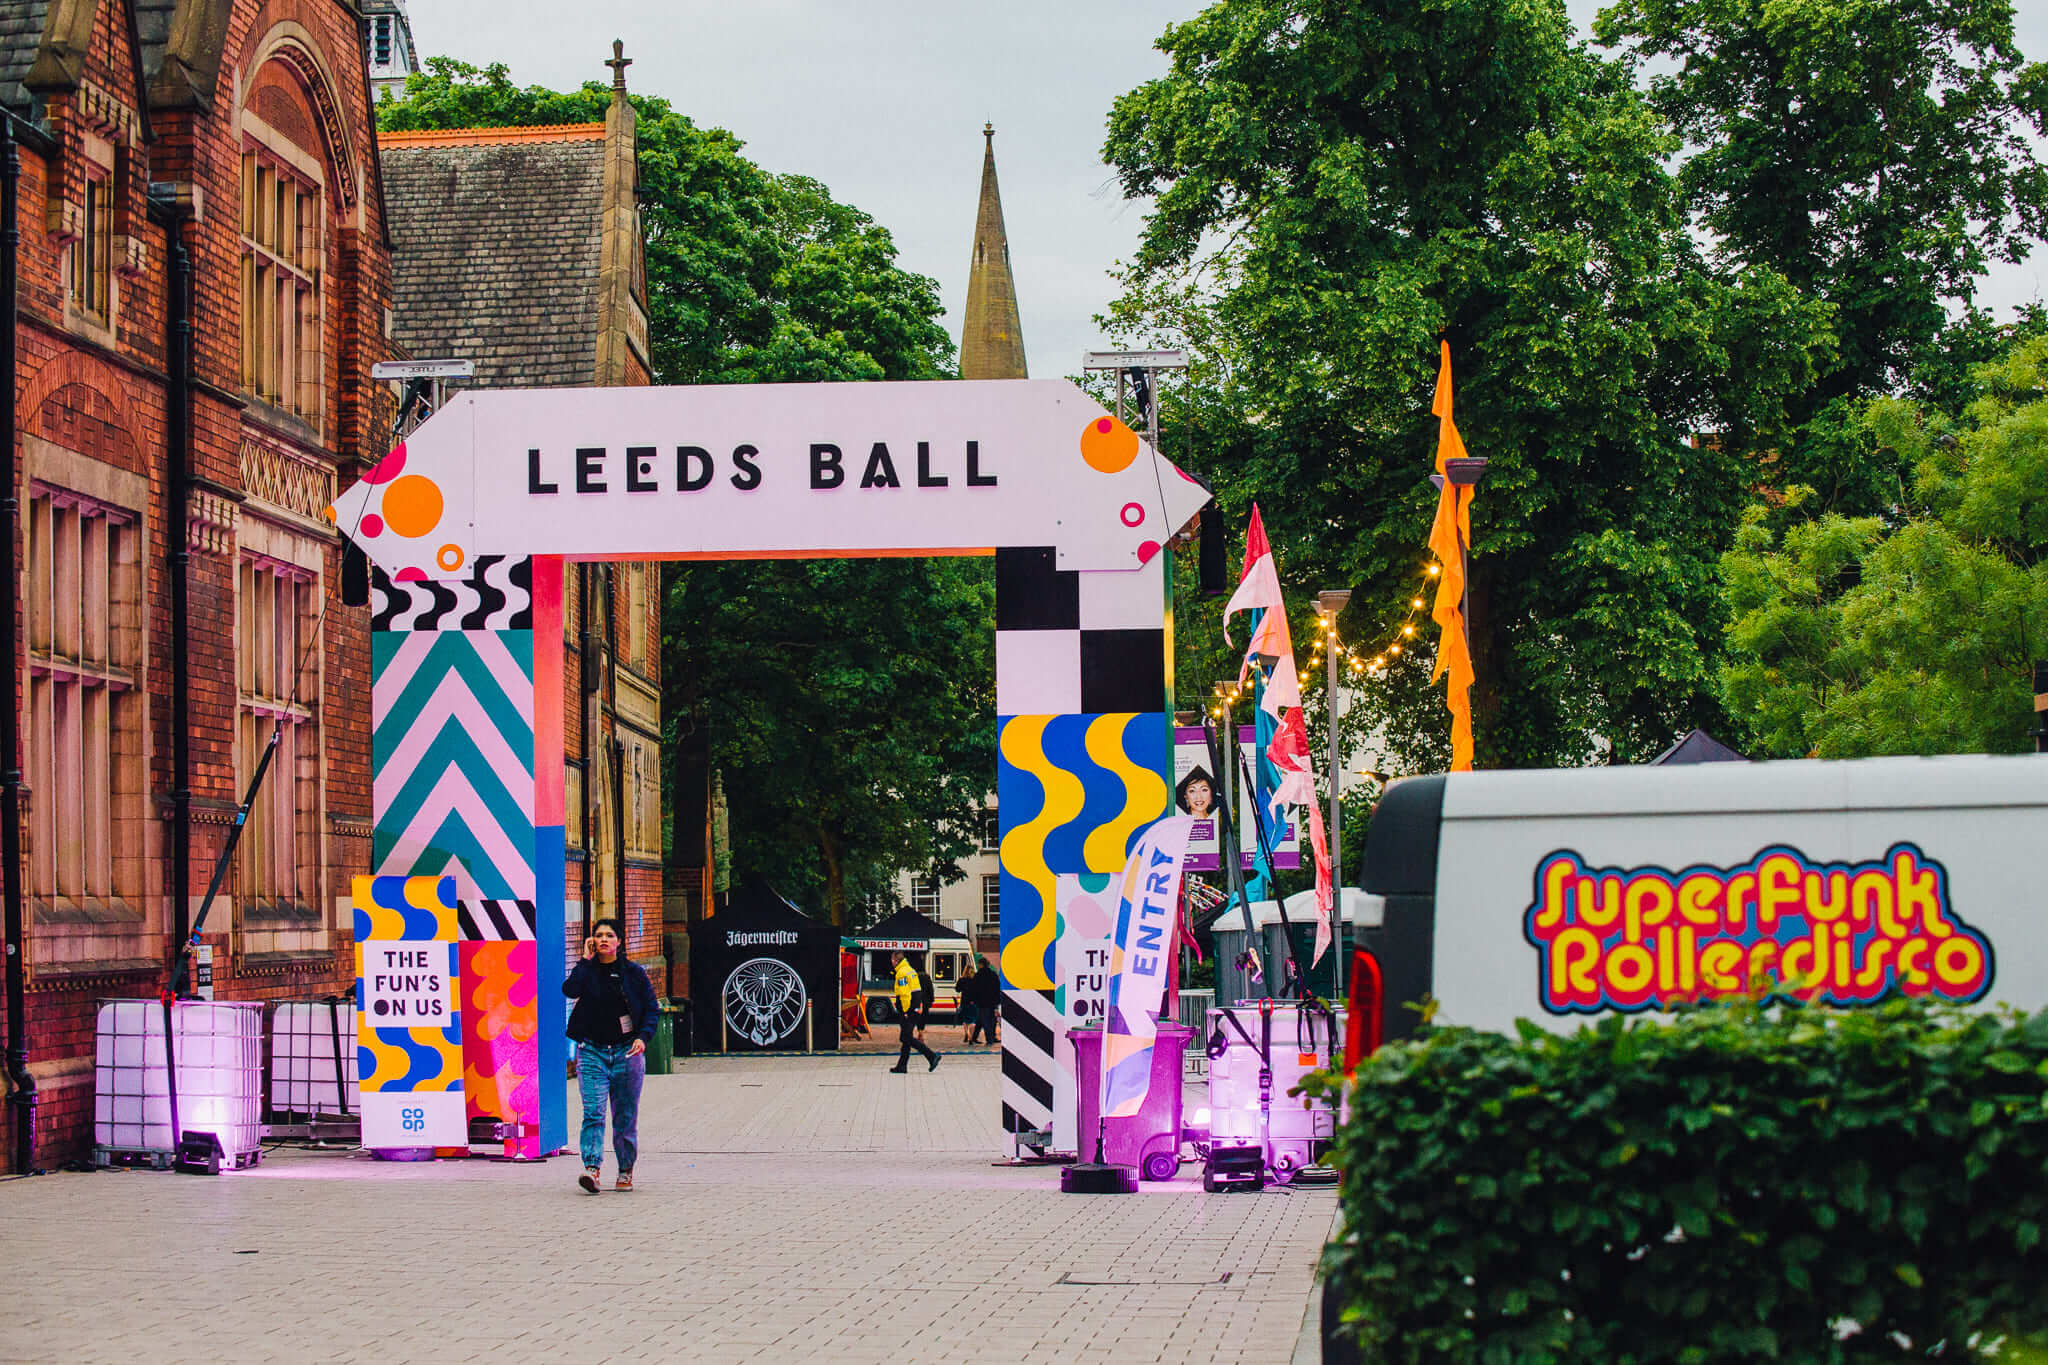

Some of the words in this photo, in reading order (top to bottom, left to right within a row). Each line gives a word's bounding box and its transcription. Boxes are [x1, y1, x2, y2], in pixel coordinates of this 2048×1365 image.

[527, 443, 763, 496] LEEDS
[809, 440, 999, 491] BALL
[1132, 846, 1174, 977] ENTRY
[901, 940, 924, 949] VAN
[383, 951, 428, 968] THE
[375, 974, 440, 992] FUN'S
[373, 999, 406, 1016] ON
[415, 998, 443, 1016] US
